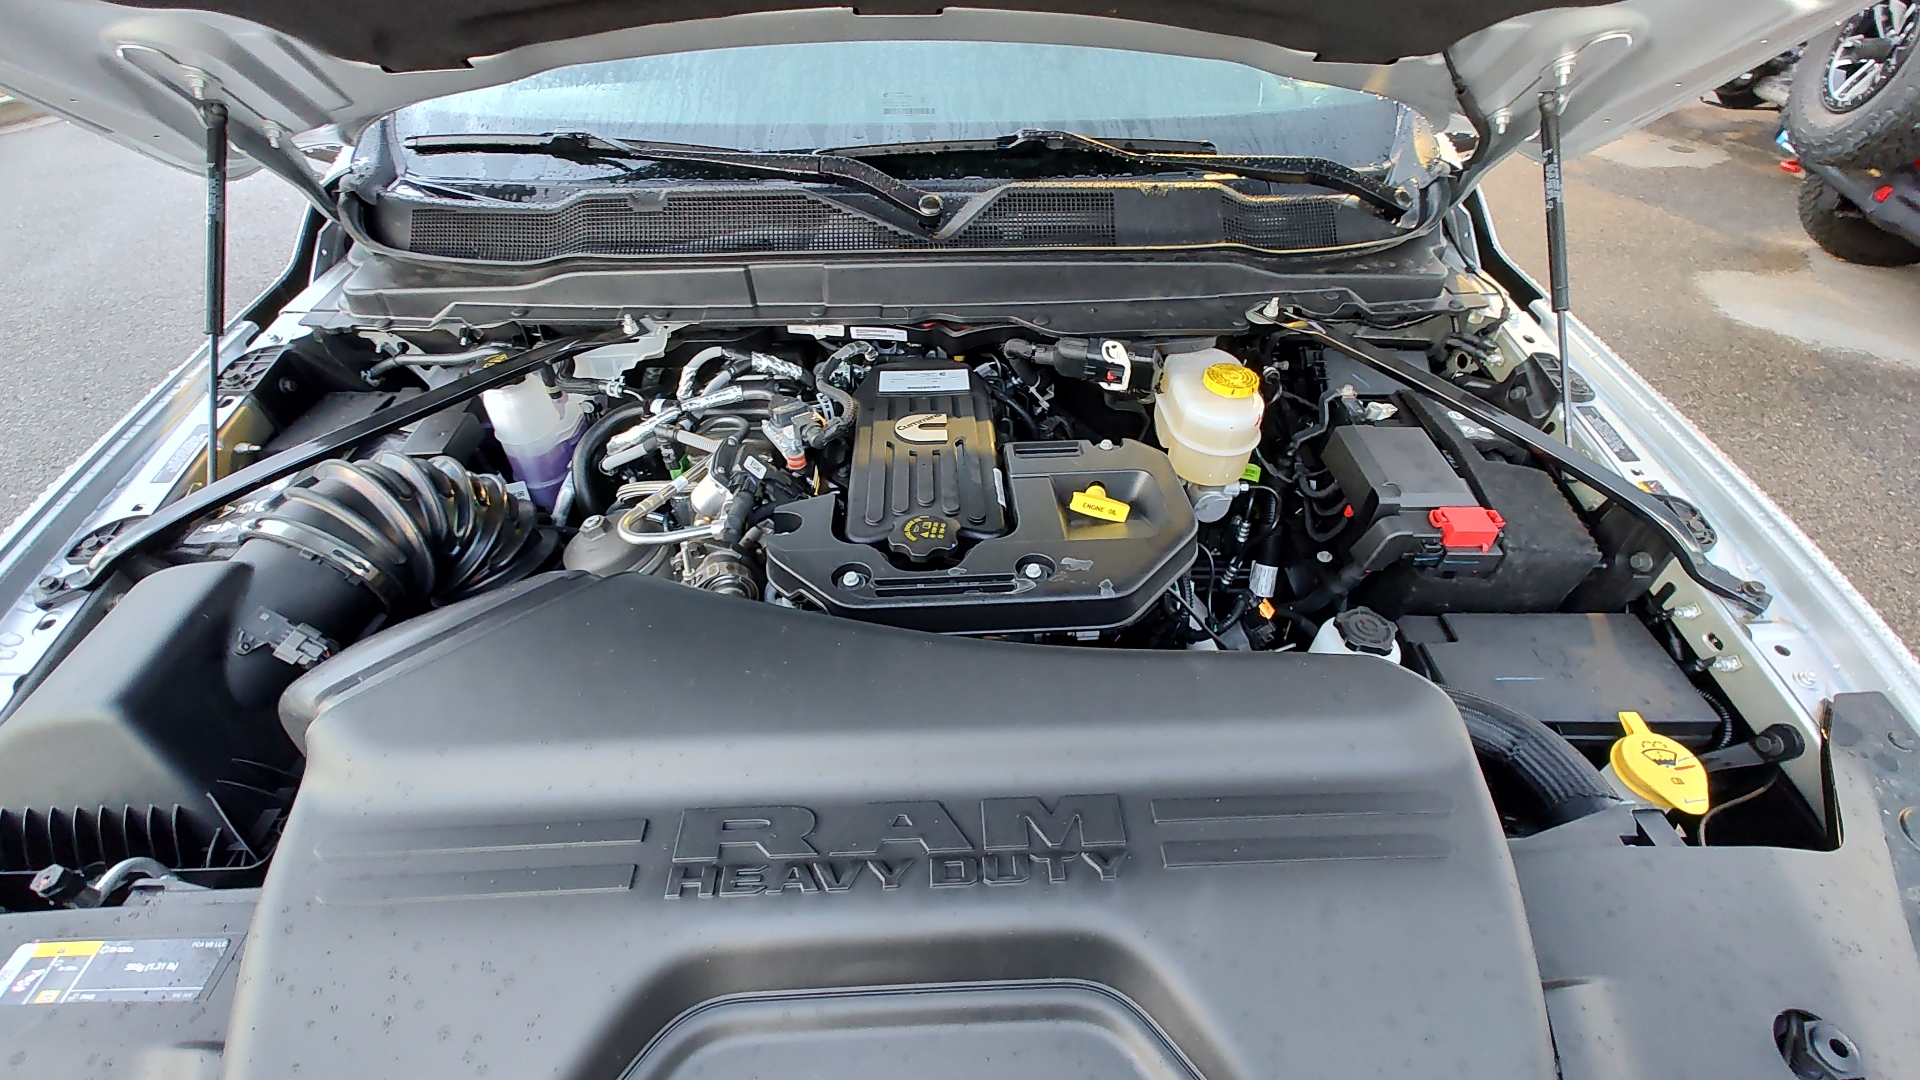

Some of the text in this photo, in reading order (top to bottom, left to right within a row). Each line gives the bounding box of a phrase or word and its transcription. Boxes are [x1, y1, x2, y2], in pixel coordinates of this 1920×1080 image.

[1083, 502, 1117, 516] ENGINE OIL
[671, 793, 1127, 863] RAM
[664, 850, 1128, 900] HEAVY DUTY
